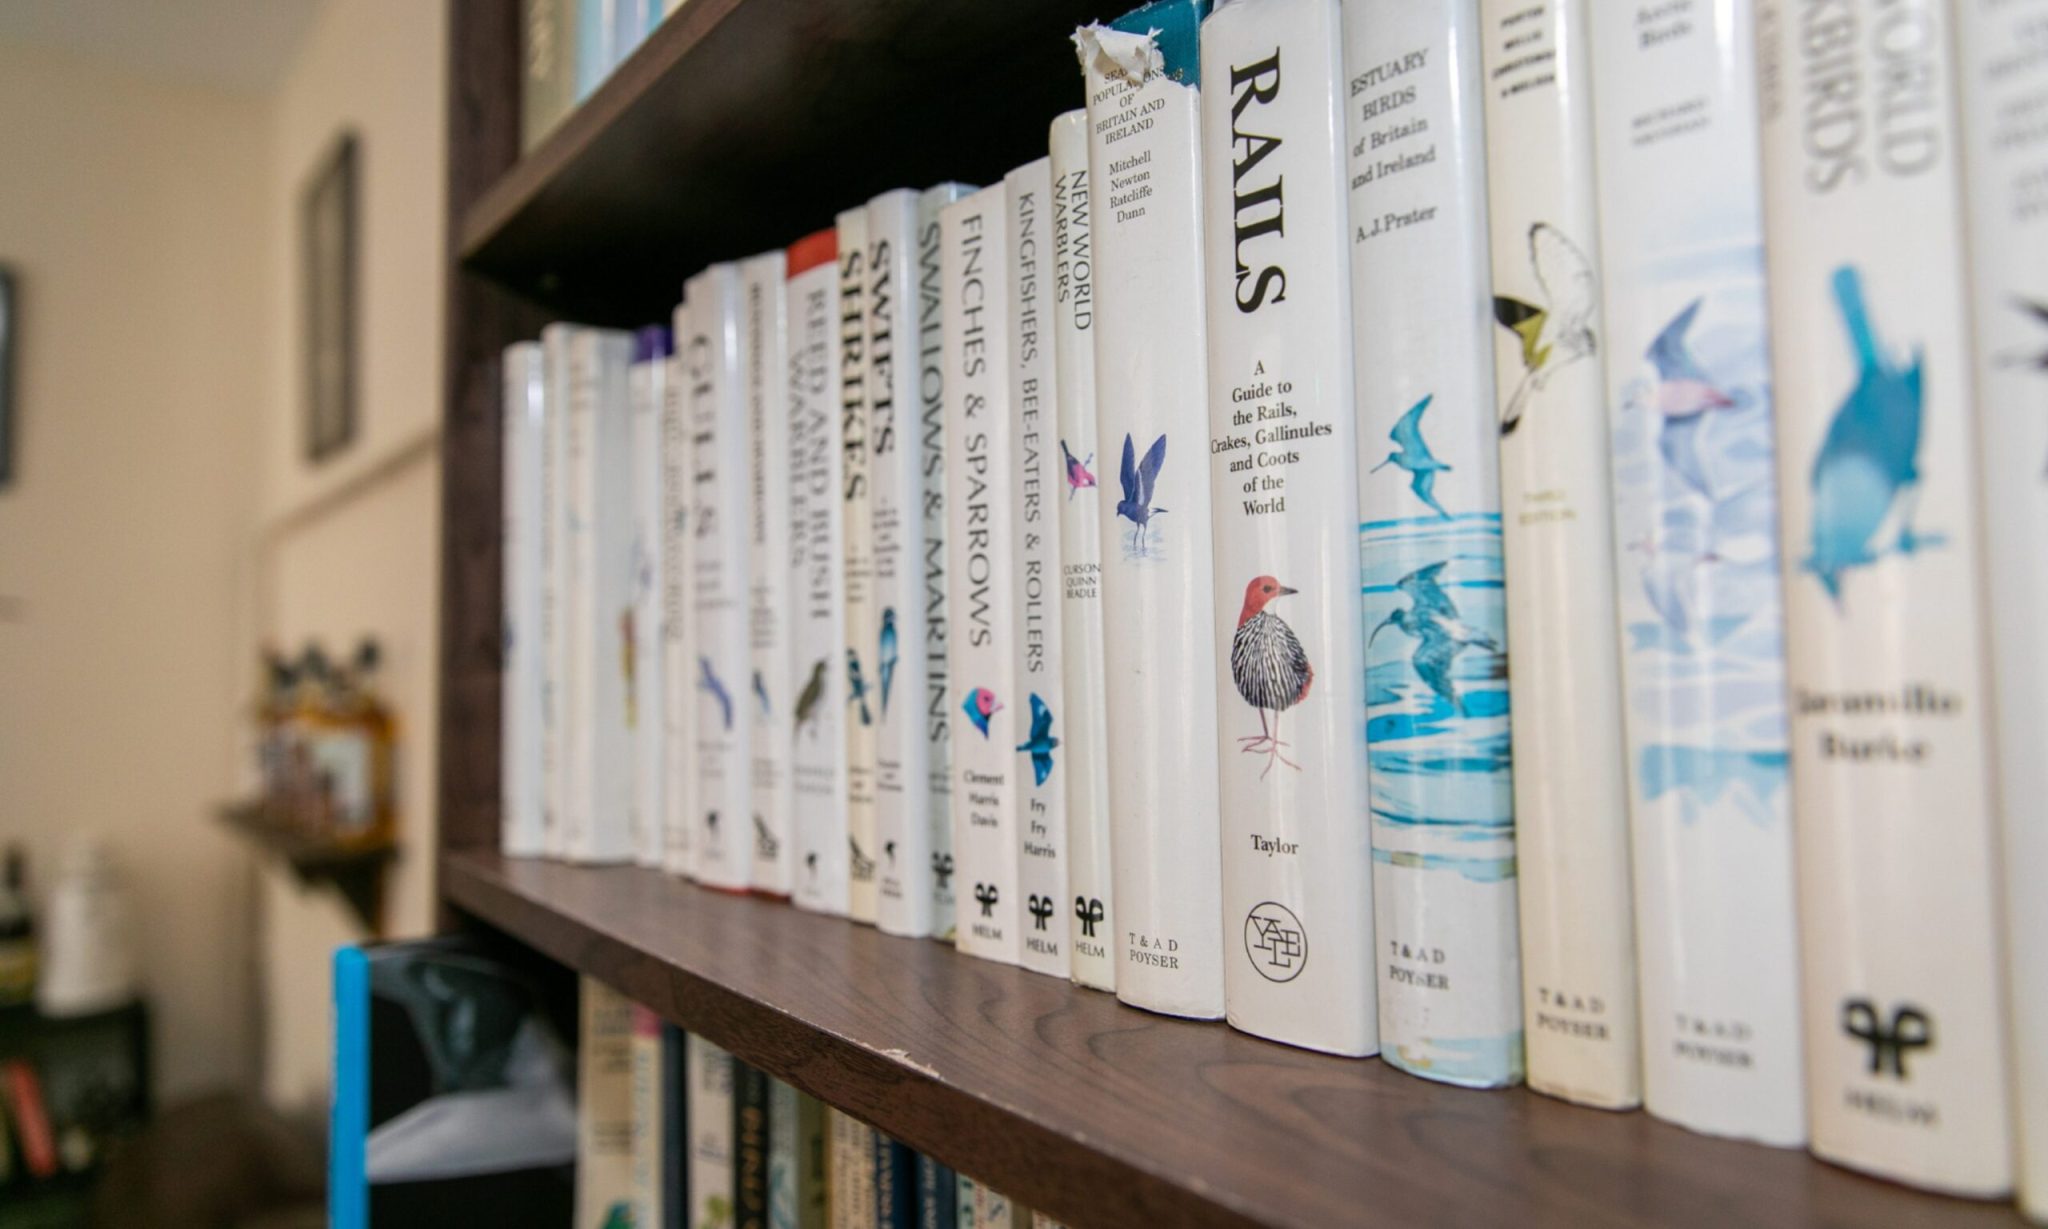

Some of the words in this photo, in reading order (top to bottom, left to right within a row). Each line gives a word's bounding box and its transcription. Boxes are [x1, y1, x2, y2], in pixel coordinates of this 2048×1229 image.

[1351, 48, 1429, 98] ESTUARY
[1119, 93, 1136, 109] OF
[1871, 0, 1941, 178] ORLD
[1096, 107, 1138, 134] BRITAIN
[1140, 98, 1165, 119] AND
[1363, 86, 1417, 121] BIRDS
[1105, 118, 1154, 145] IRELAND
[1353, 136, 1366, 158] of
[1370, 117, 1429, 150] Britain
[1109, 150, 1151, 176] Mitchell
[1351, 163, 1374, 191] and
[1376, 144, 1437, 179] Ireland
[1111, 170, 1151, 192] Newton
[1230, 46, 1286, 313] RAILS
[1070, 169, 1090, 227] NEW
[1110, 186, 1153, 209] Ratcliffe
[1117, 206, 1146, 224] Dunn
[1054, 174, 1069, 304] WARBLERS
[1019, 193, 1039, 368] KINGFISHERS,
[1072, 230, 1092, 331] WORLD
[962, 213, 985, 378] FINCHES
[869, 238, 895, 456] SWIFTS
[918, 221, 943, 478] SWALLOWS
[840, 248, 867, 502] SHRIKES
[1254, 360, 1265, 376] A
[1232, 384, 1272, 403] Guide
[1277, 381, 1292, 395] to
[965, 393, 986, 418] &
[1233, 410, 1252, 427] the
[1257, 402, 1297, 422] Rails,
[1211, 436, 1251, 454] Crakes,
[1255, 421, 1332, 445] Gallinules
[1021, 378, 1041, 523] BEE-EATERS
[1229, 455, 1253, 473] and
[1257, 450, 1300, 469] Coots
[1243, 477, 1258, 494] of
[1262, 475, 1284, 491] the
[924, 489, 943, 520] &
[1243, 497, 1286, 517] World
[965, 433, 992, 647] SPARROWS
[1025, 533, 1041, 550] &
[1063, 563, 1101, 577] CURSON
[1066, 576, 1097, 588] QUINN
[1025, 560, 1044, 673] ROLLERS
[924, 538, 949, 743] MARTINS
[1029, 798, 1046, 815] Fry
[1030, 819, 1047, 836] Fry
[1024, 840, 1056, 859] Harris
[1250, 834, 1299, 856] Taylor
[972, 923, 1003, 941] HELM
[1129, 932, 1136, 945] T
[1139, 935, 1149, 948] &
[1153, 937, 1163, 951] A
[1168, 939, 1179, 952] D
[1026, 937, 1058, 957] HELM
[1075, 940, 1105, 958] HELM
[1129, 949, 1179, 970] POYSER
[1391, 941, 1399, 957] T
[1401, 945, 1413, 961] &
[1417, 948, 1429, 963] A
[1433, 948, 1446, 964] D
[1537, 1012, 1610, 1040] POYSER
